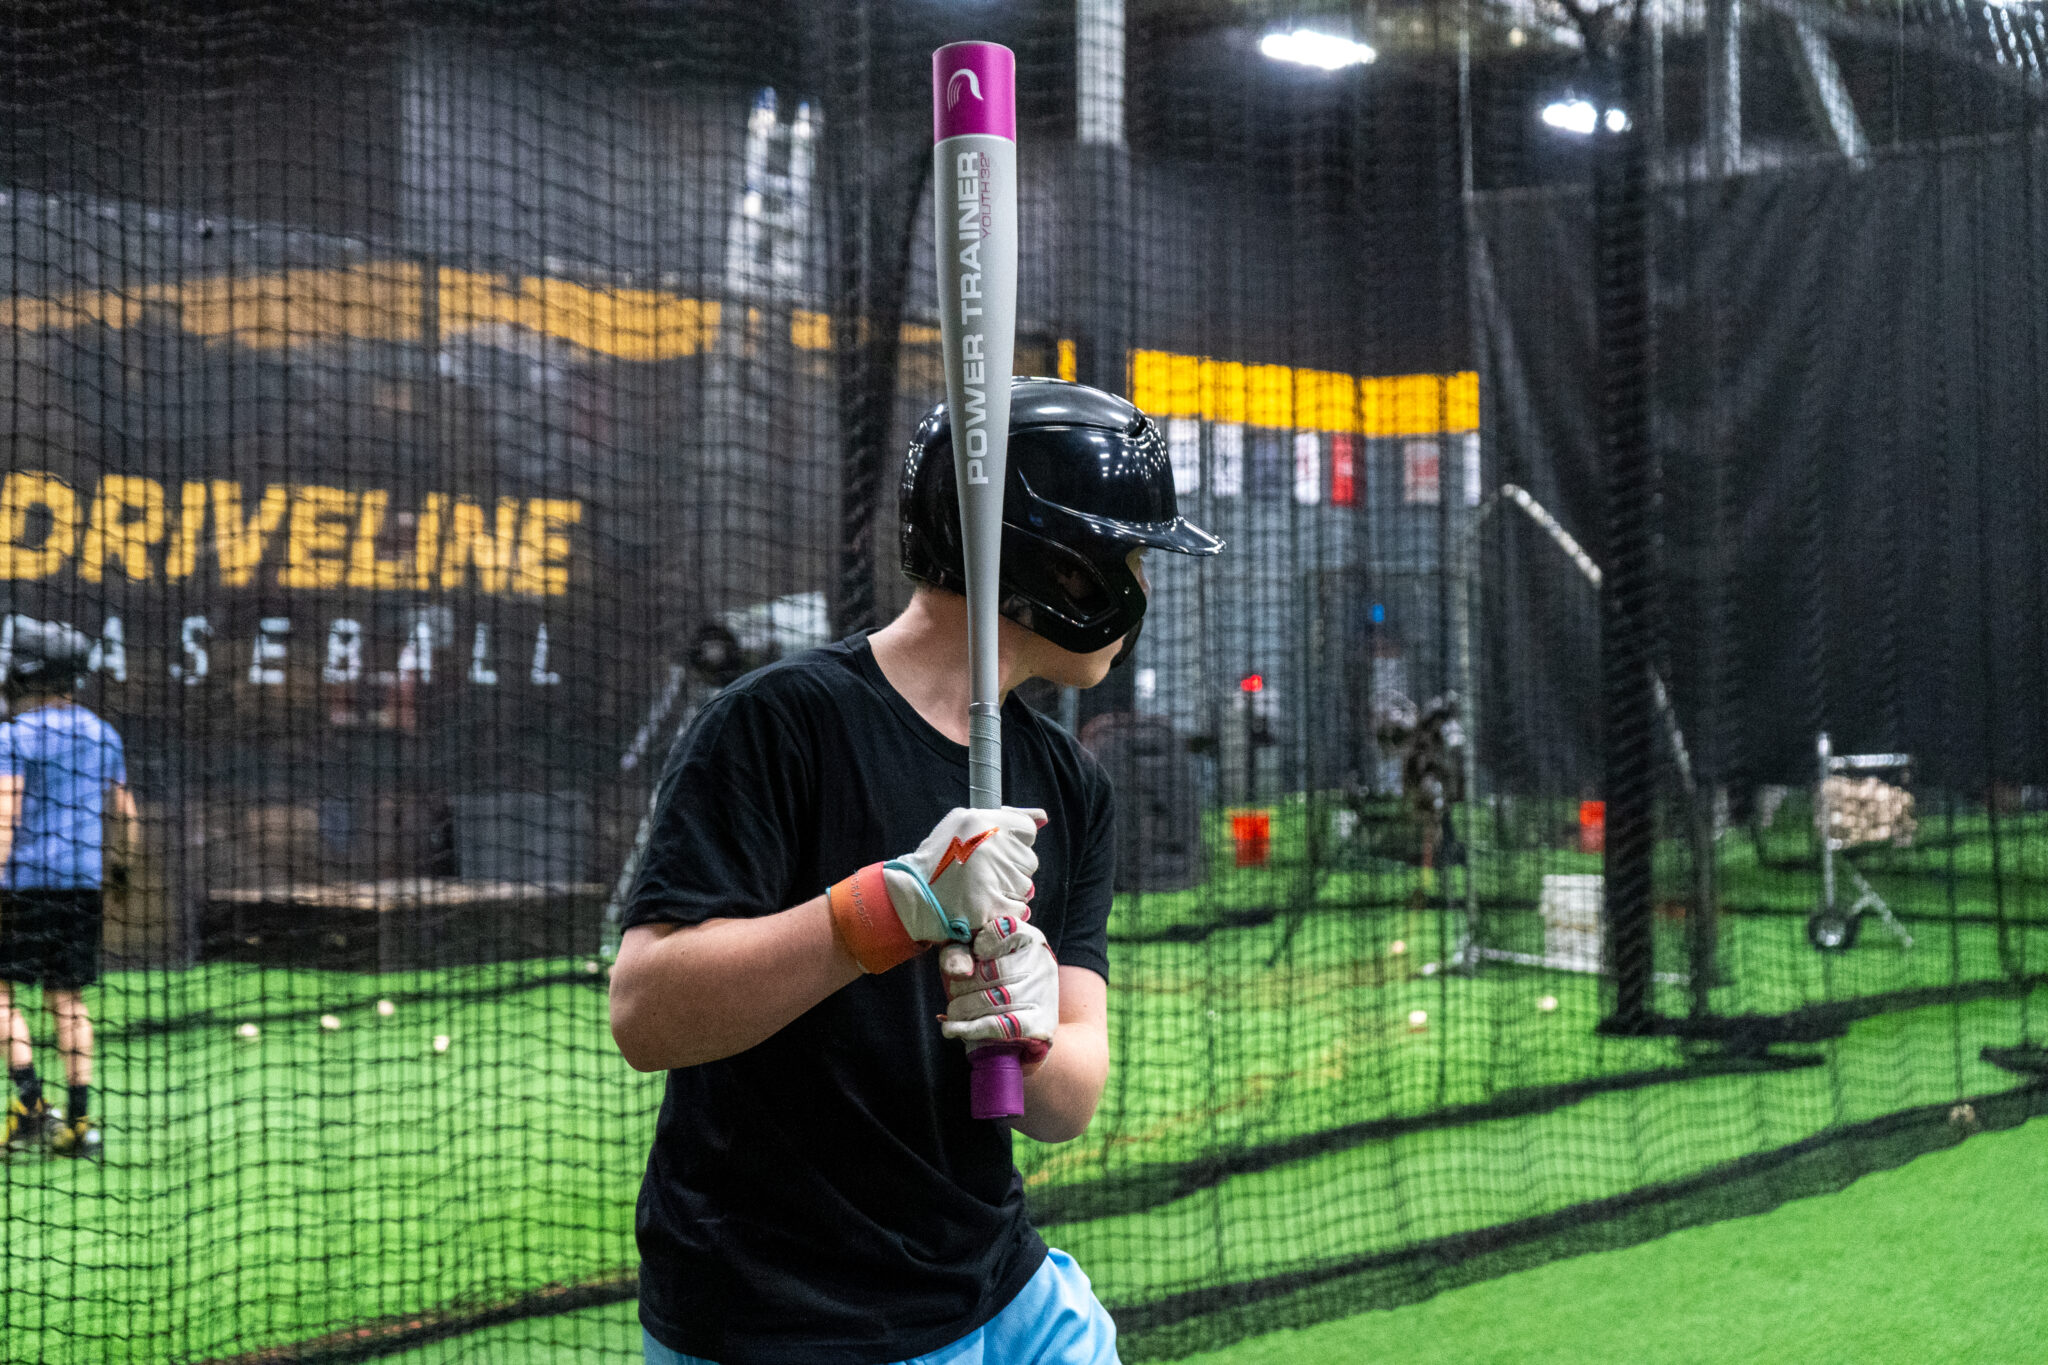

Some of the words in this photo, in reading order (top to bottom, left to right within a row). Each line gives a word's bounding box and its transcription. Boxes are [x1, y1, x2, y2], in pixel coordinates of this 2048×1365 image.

[957, 151, 983, 325] TRAINER
[979, 181, 993, 239] YOUTH
[962, 333, 989, 485] POWER
[0, 470, 583, 596] DRIVELINE
